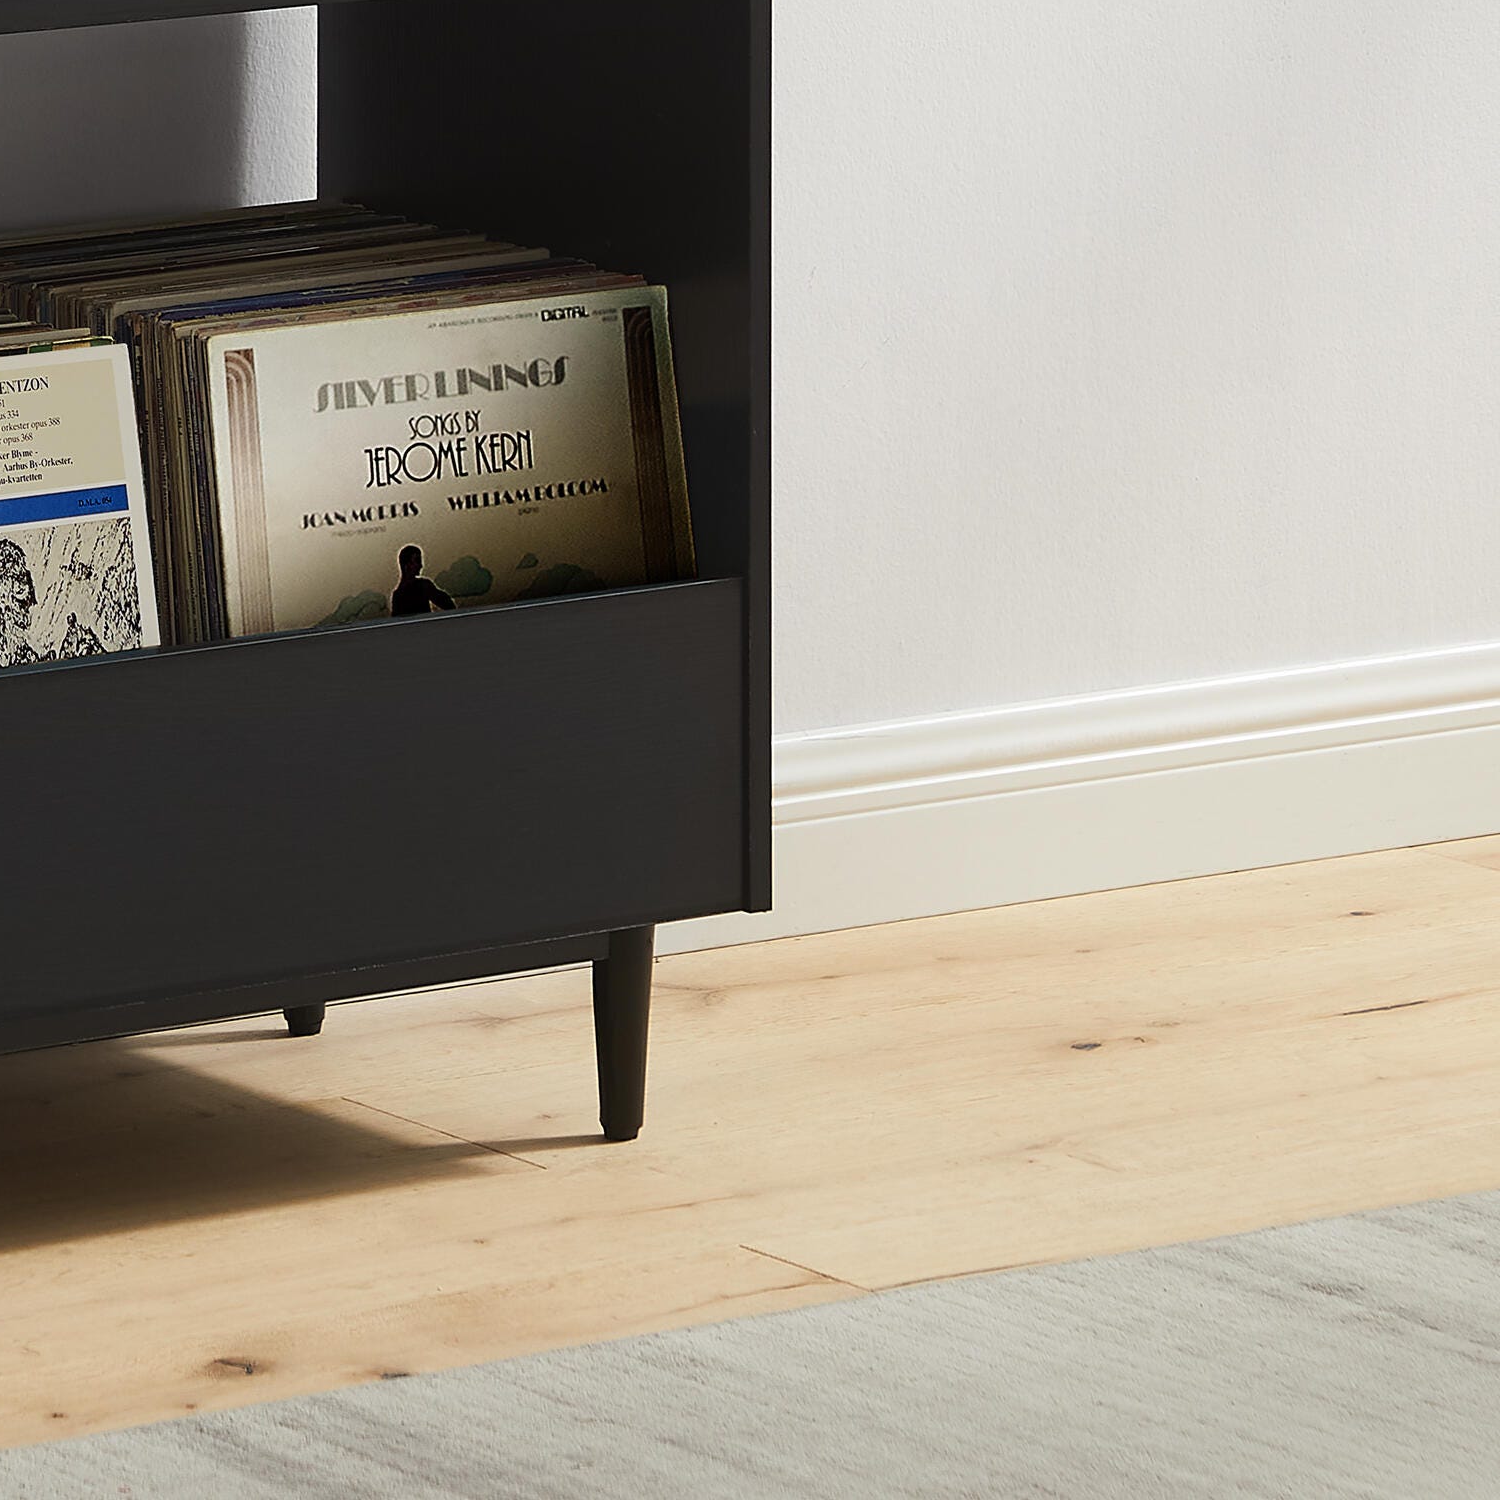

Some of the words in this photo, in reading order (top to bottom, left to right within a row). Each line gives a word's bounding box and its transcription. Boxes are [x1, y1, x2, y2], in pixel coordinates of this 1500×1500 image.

[541, 306, 589, 321] DIGITAL
[314, 374, 430, 413] SILVER
[434, 356, 569, 398] LININGS
[1, 423, 29, 432] orkester
[31, 421, 47, 429] opus
[409, 412, 461, 440] SONGS
[465, 410, 481, 432] BY
[3, 437, 20, 445] opus
[11, 450, 33, 460] Blyme
[365, 437, 468, 488] JEROME
[475, 430, 534, 477] KERN
[3, 462, 28, 472] Aarhus
[448, 488, 531, 510] WILLIAM
[301, 512, 346, 529] JOAN
[350, 501, 419, 522] MORRIS
